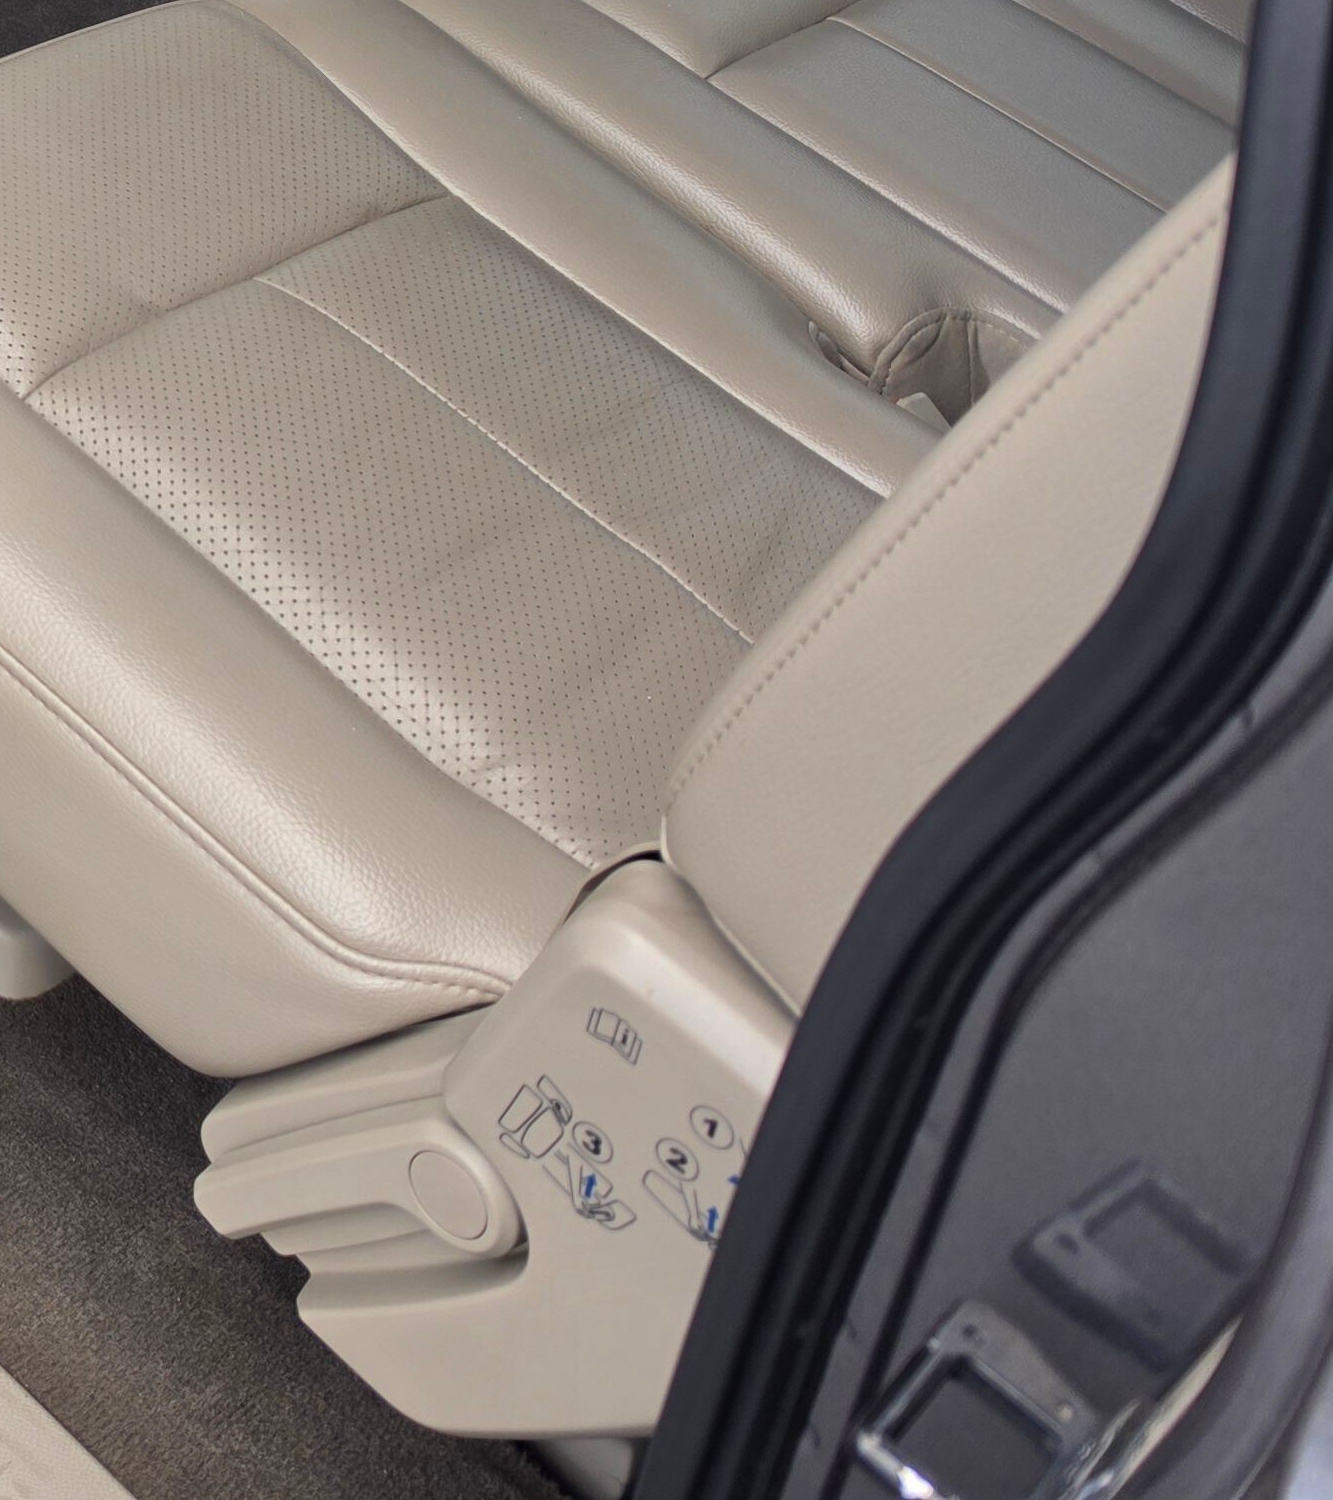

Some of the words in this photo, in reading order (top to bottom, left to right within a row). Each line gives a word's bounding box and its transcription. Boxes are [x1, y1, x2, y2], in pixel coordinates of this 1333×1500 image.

[703, 1118, 719, 1139] 1
[582, 1129, 602, 1156] 3
[666, 1147, 688, 1174] 2
